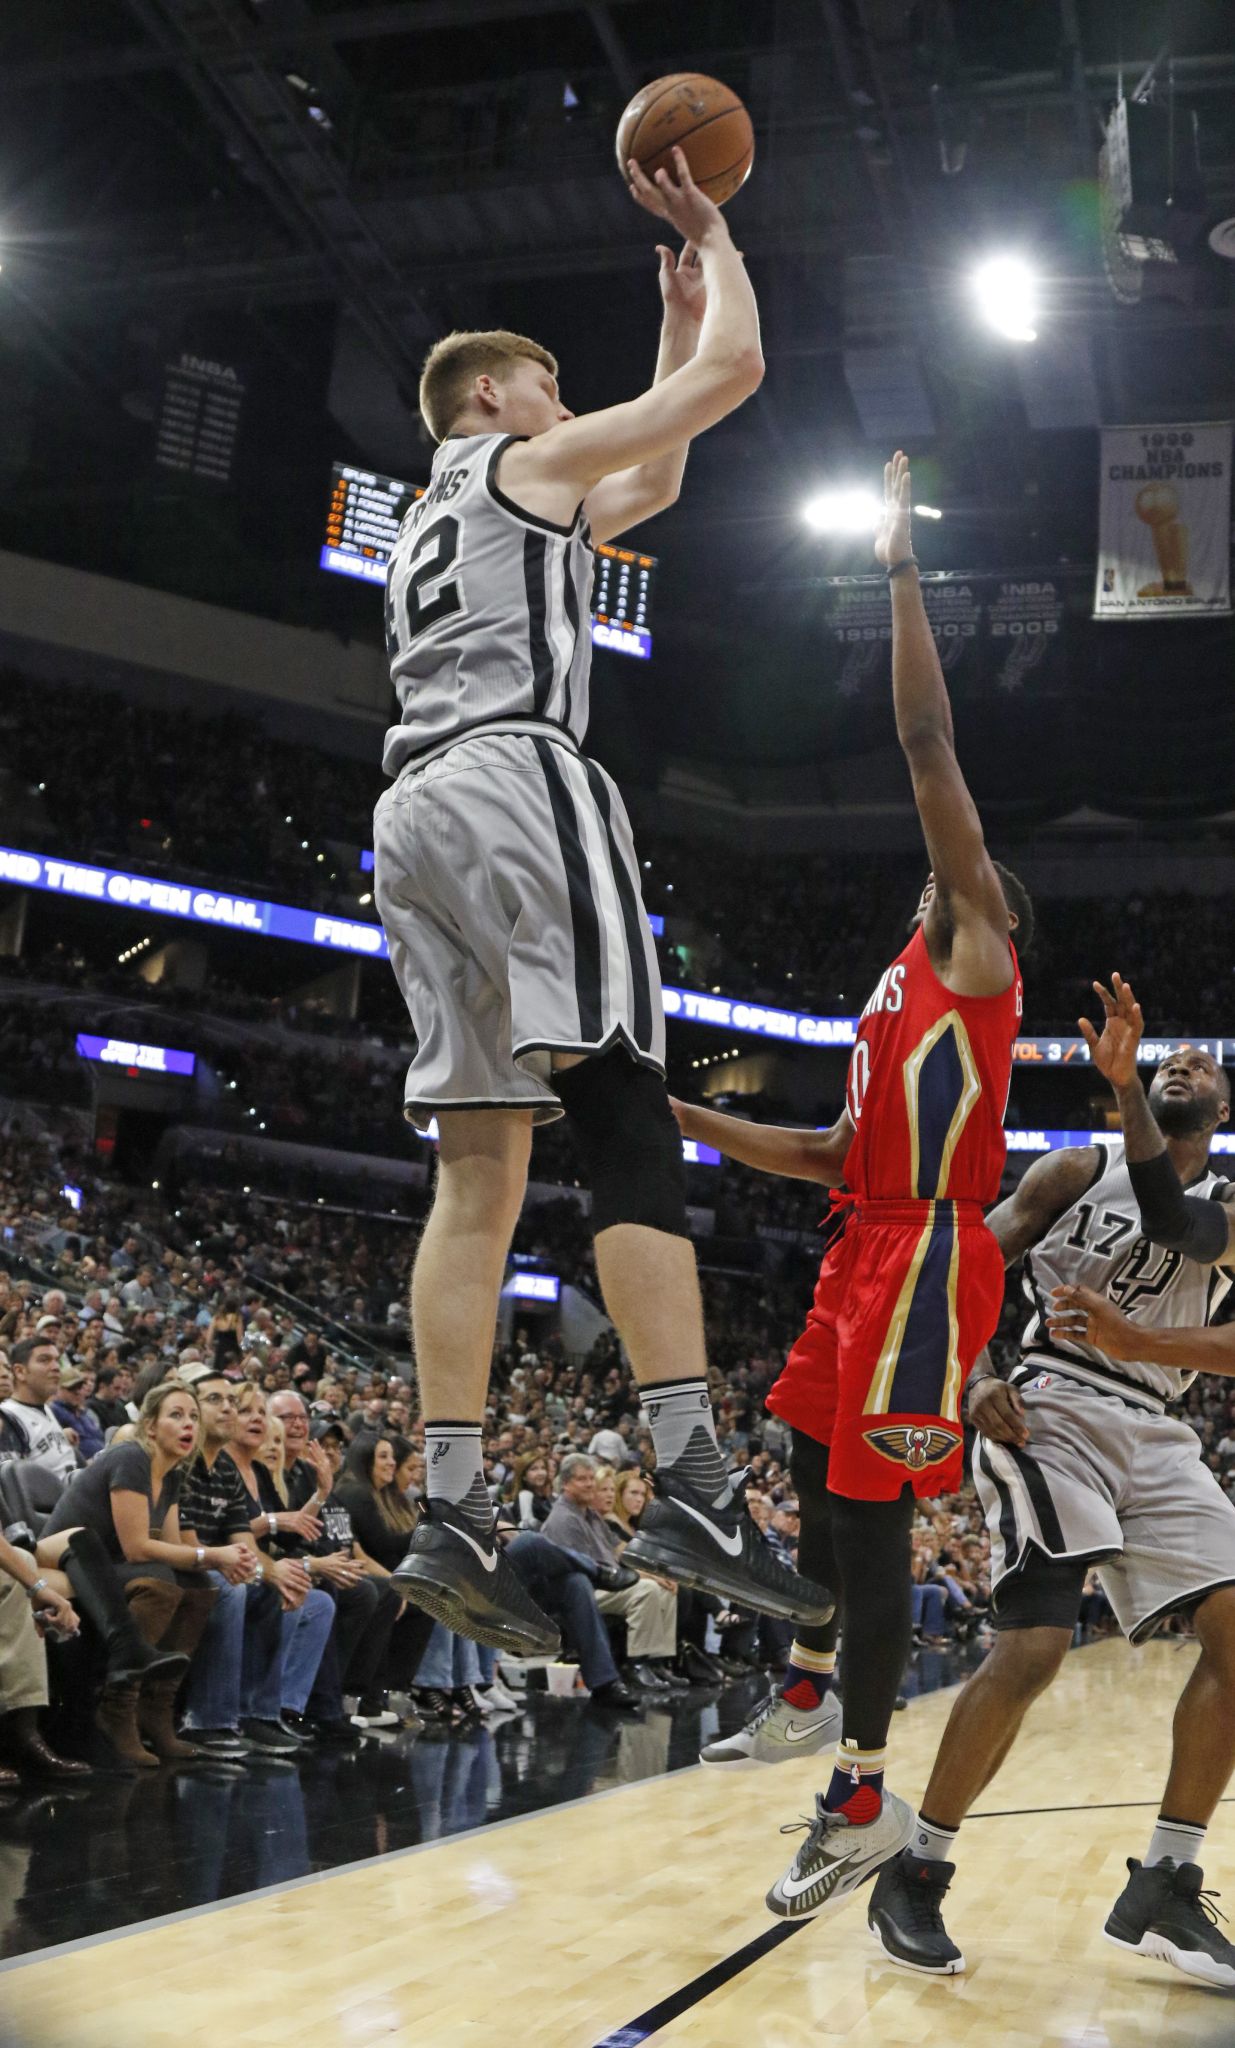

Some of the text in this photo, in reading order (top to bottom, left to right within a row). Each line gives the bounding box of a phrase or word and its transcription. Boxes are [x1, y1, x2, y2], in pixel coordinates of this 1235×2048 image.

[1109, 462, 1223, 480] CHAMPIONS
[1147, 449, 1185, 463] NBA
[593, 625, 645, 655] CAN.
[992, 620, 1058, 636] 2005
[0, 850, 263, 928] ND THE OPEN CAN.
[314, 917, 382, 952] FIND
[682, 994, 731, 1023] THE
[732, 1005, 797, 1037] OPEN
[798, 1018, 857, 1043] CAN.
[1048, 1043, 1061, 1061] 3
[1064, 1200, 1137, 1260] 17
